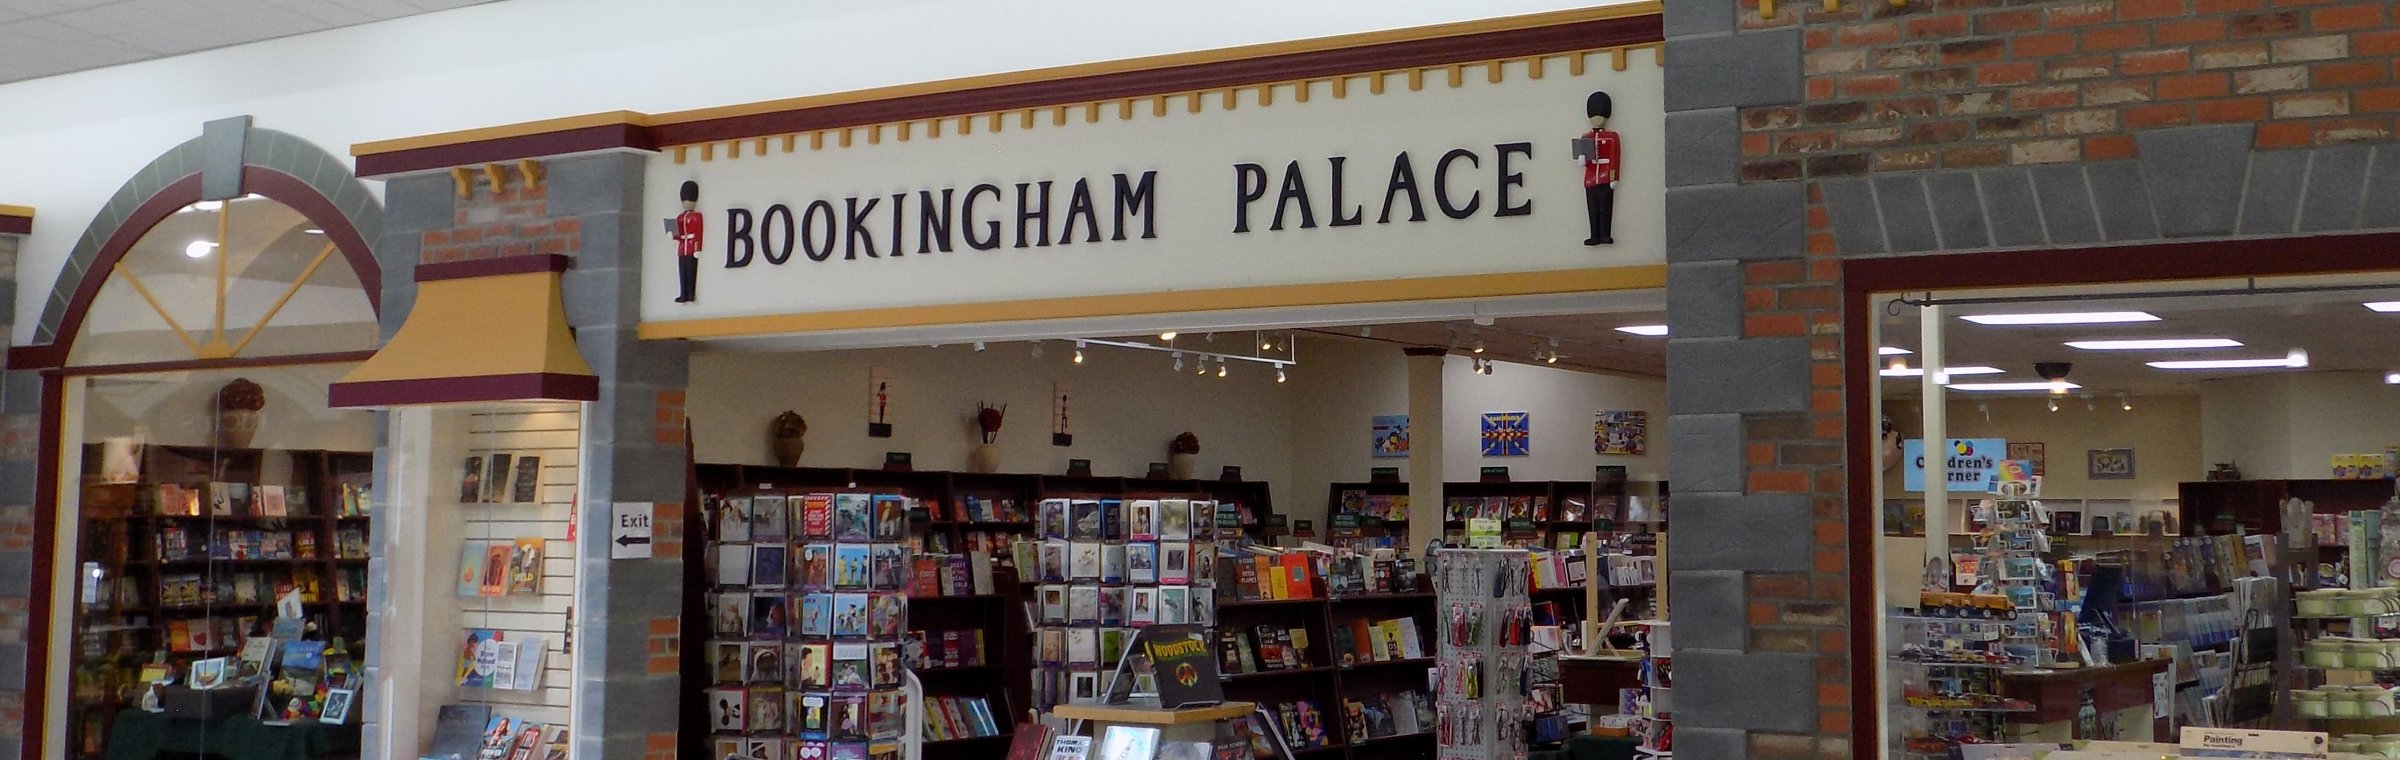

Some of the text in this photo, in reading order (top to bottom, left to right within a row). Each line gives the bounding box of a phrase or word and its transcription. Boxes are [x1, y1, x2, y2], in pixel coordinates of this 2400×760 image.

[724, 142, 1532, 268] BOOKINGHAM PALACE
[1915, 454, 1993, 469] Cdren's
[1947, 471, 1982, 481] rner
[621, 513, 649, 528] Exit
[1153, 640, 1207, 657] WOODSTOCK
[2203, 734, 2243, 746] Painting
